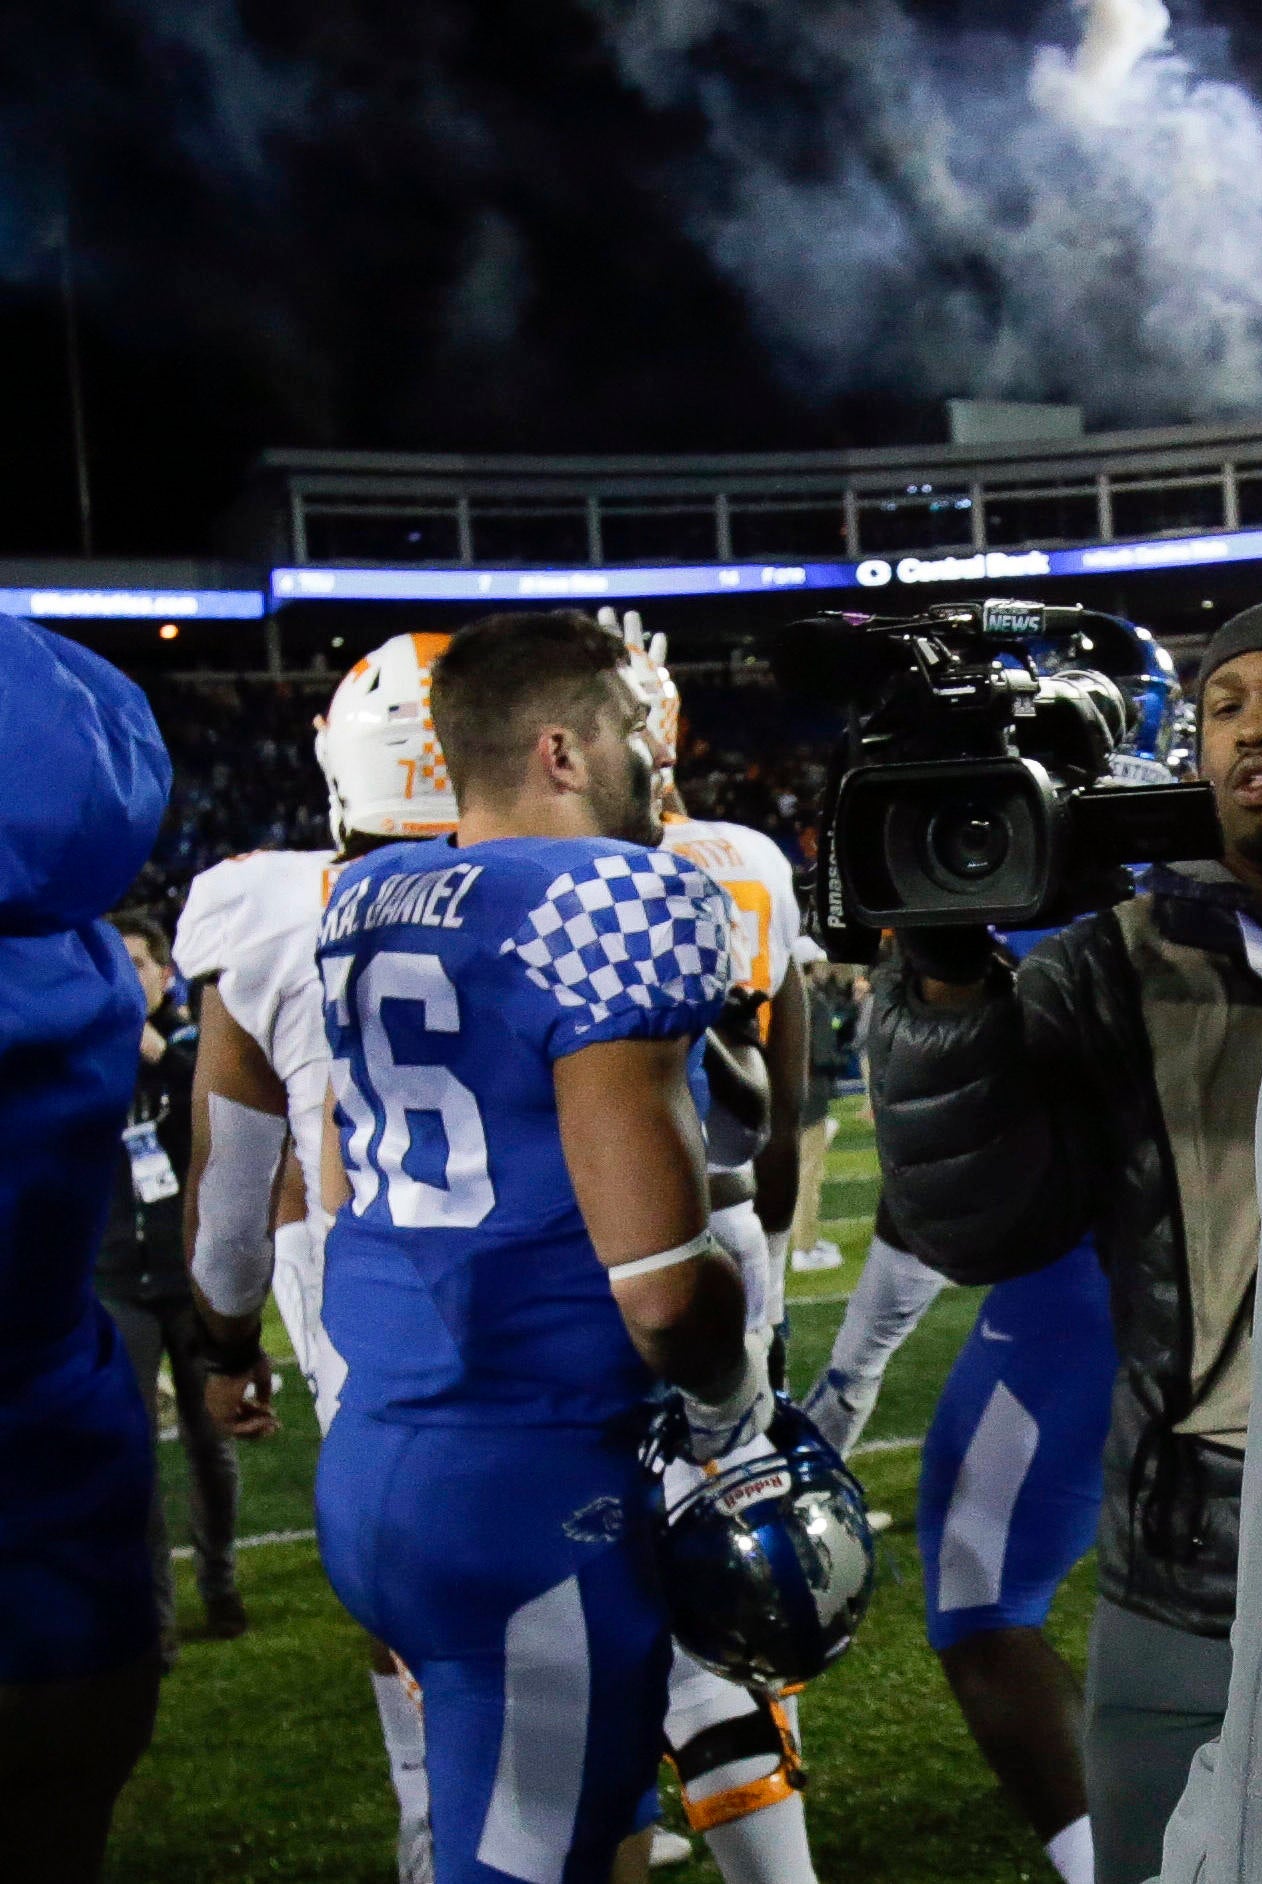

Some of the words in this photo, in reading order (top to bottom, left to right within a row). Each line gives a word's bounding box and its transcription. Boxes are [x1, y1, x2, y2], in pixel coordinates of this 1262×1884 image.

[988, 614, 1042, 632] NEWS
[397, 758, 417, 800] 7
[722, 1473, 784, 1509] Riddell
